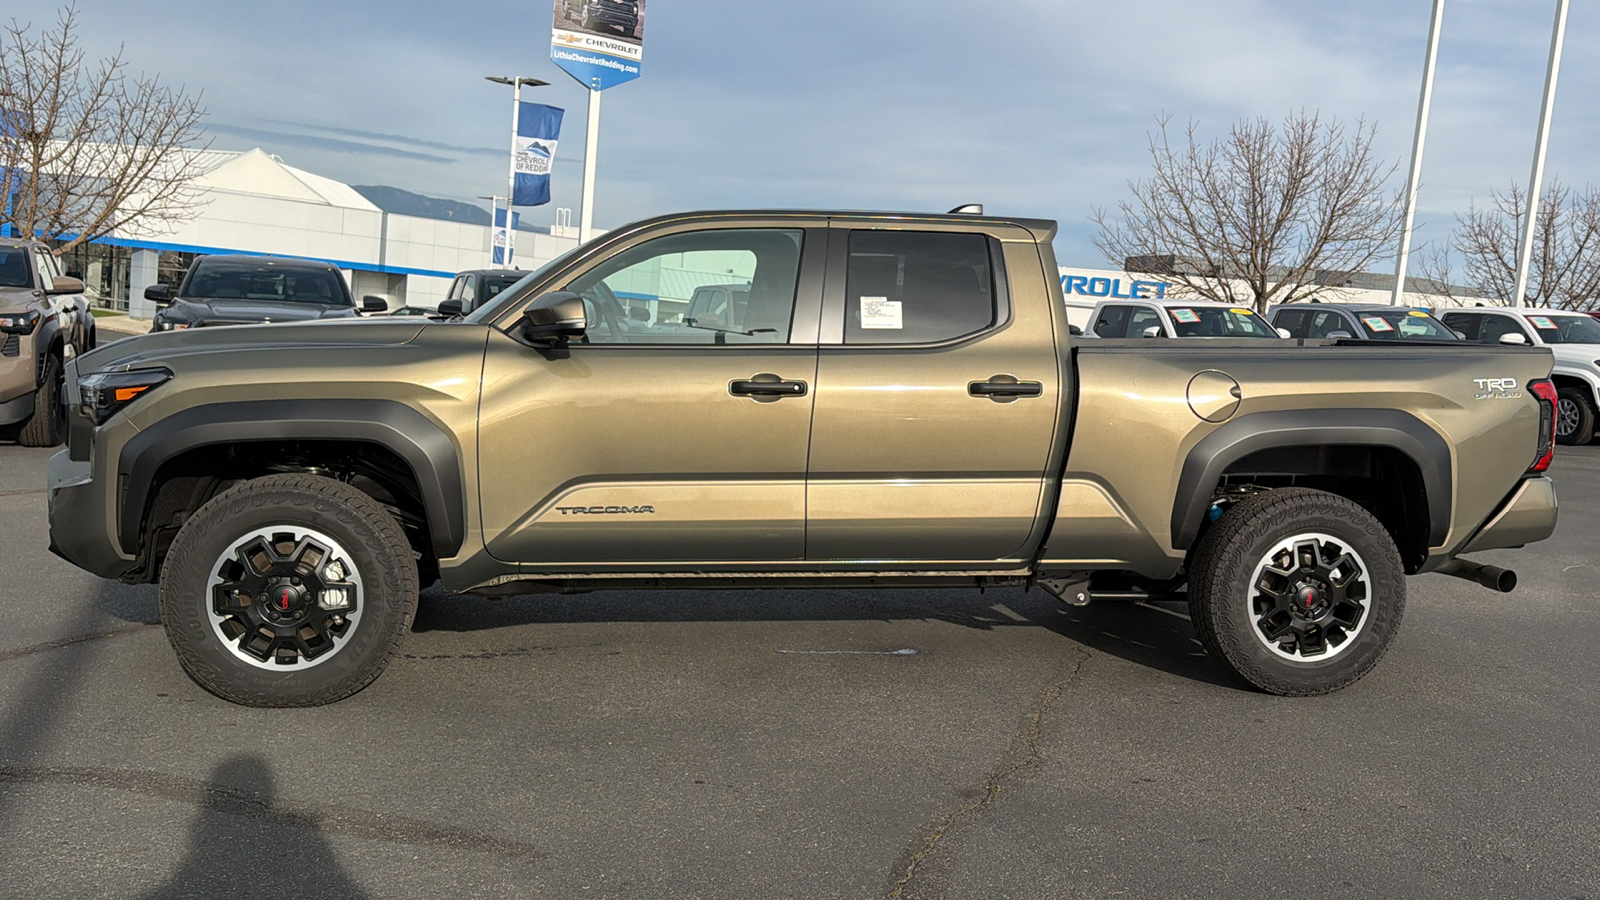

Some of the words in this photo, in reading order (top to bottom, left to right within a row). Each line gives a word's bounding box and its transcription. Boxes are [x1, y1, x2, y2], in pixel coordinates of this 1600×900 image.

[586, 38, 638, 55] CHEVROLET
[554, 50, 638, 73] LithiaChevroletRedding.com
[516, 162, 525, 170] OF
[1473, 378, 1518, 392] TRD
[555, 505, 656, 515] TACOMA
[281, 589, 289, 610] TRD
